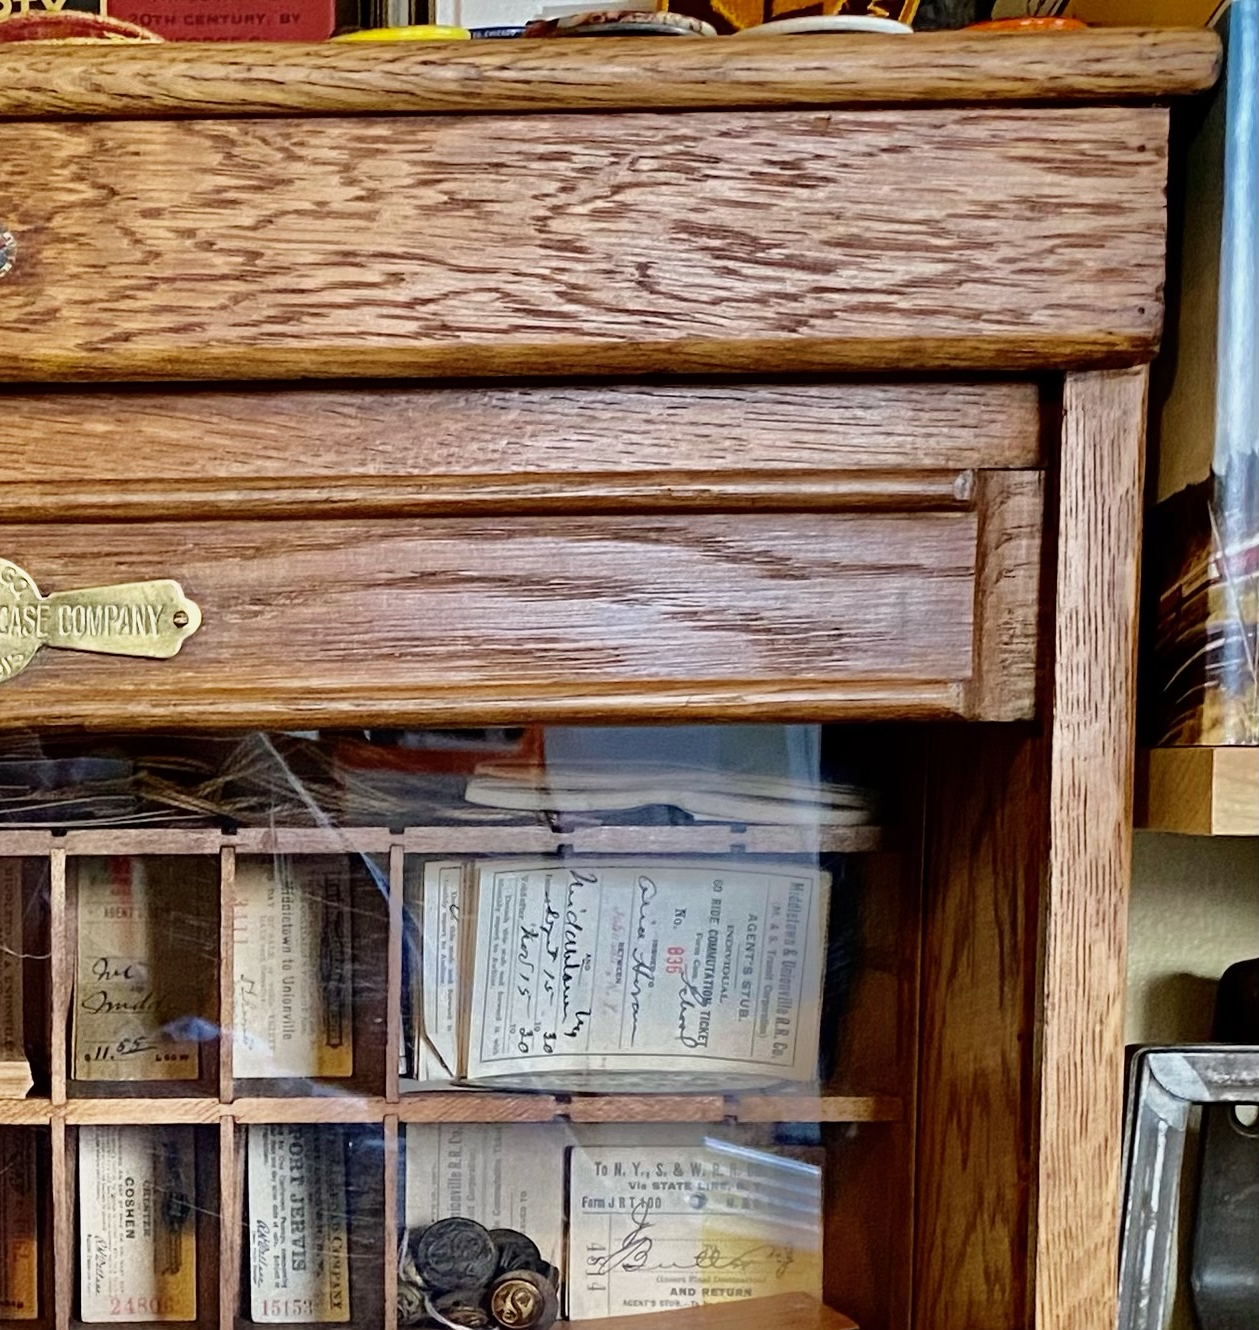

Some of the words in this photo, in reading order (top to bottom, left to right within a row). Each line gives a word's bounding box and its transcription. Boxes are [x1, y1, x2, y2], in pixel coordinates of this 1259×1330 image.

[280, 13, 301, 25] BY
[58, 604, 162, 638] COMPANY
[673, 908, 686, 930] No.
[707, 899, 721, 924] RIDE
[741, 914, 758, 976] AGENT'S
[781, 948, 798, 957] &
[282, 960, 294, 971] to
[701, 929, 719, 1007] COMMUTATION
[738, 980, 754, 1023] STUB.
[777, 960, 797, 1015] Unionville
[282, 976, 294, 1040] Unionville
[696, 1011, 712, 1049] TICKET
[289, 1128, 305, 1185] PORT
[595, 1162, 607, 1177] To
[614, 1162, 625, 1177] N.
[656, 1162, 667, 1177] S.
[673, 1162, 684, 1177] &
[652, 1181, 691, 1190] STATE
[582, 1196, 606, 1209] Form
[608, 1196, 612, 1209] J
[619, 1196, 625, 1209] R
[290, 1194, 307, 1271] JERVIS
[670, 1287, 696, 1297] AND
[702, 1287, 752, 1297] RETURN
